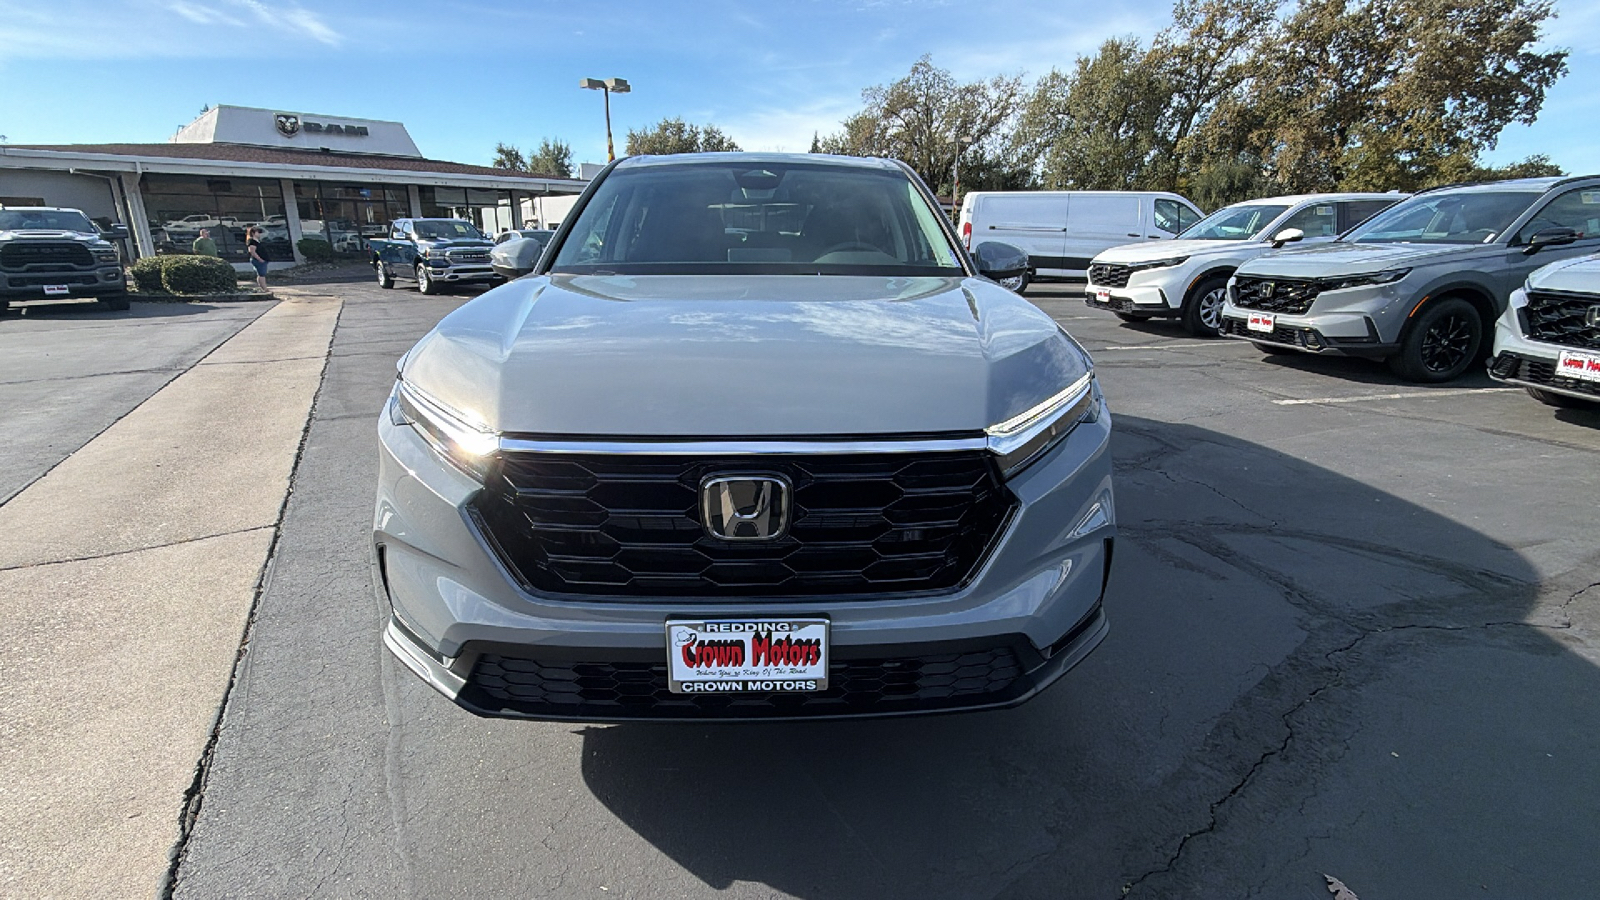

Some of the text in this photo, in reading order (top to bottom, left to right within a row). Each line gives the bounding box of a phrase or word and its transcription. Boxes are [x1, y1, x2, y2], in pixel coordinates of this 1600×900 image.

[303, 122, 369, 136] RAM
[706, 623, 790, 632] REDDING
[682, 631, 821, 668] Crown Motors
[743, 669, 760, 677] King
[762, 668, 772, 676] Of
[773, 667, 786, 675] The
[681, 680, 817, 692] CROWN MOTORS
